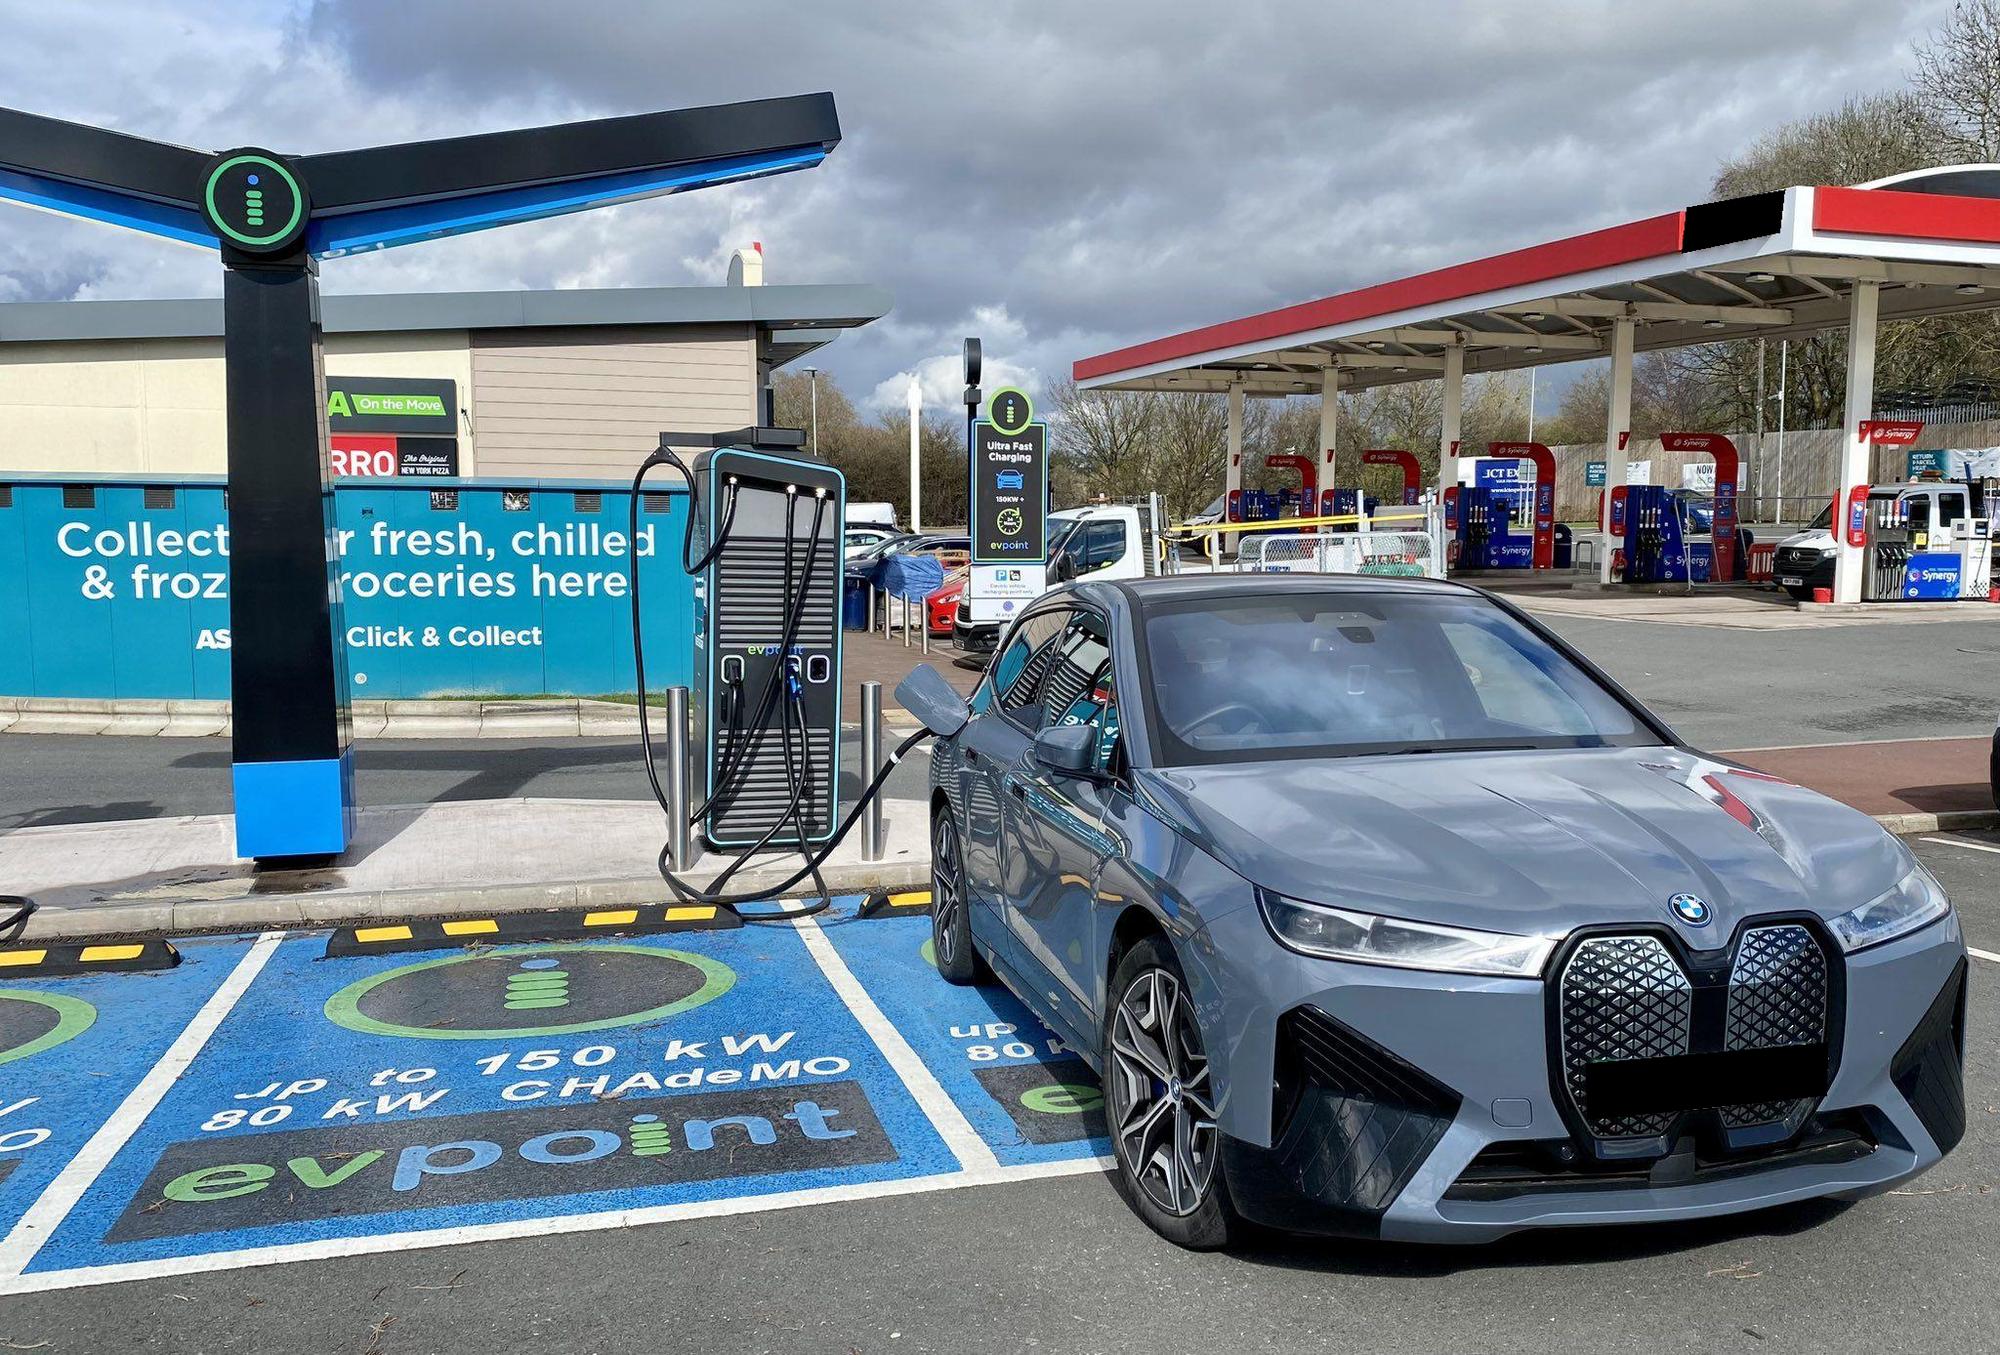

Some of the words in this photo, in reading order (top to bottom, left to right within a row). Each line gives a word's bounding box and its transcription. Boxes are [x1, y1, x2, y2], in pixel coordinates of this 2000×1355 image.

[360, 398, 379, 409] On
[383, 398, 403, 409] the
[406, 399, 440, 411] Move
[1884, 429, 1916, 440] Synergy
[987, 441, 1010, 451] Ultra
[1013, 441, 1033, 451] Fast
[331, 450, 395, 477] RRO
[988, 452, 1032, 463] Charging
[401, 467, 415, 475] NEW
[416, 467, 432, 475] YORK
[432, 467, 450, 475] PIZZA
[1697, 465, 1714, 474] NOW
[57, 521, 230, 558] Collect
[370, 521, 495, 562] fresh,
[511, 522, 656, 557] chilled
[990, 541, 1029, 552] evpoint
[1502, 546, 1530, 556] Synergy
[1676, 555, 1709, 567] Syergy
[81, 564, 115, 600] &
[131, 563, 228, 599] froz
[1922, 569, 1958, 583] Synergy
[346, 626, 414, 647] Click
[421, 626, 441, 647] &
[448, 626, 543, 647] Collect
[949, 1022, 1018, 1039] up
[369, 1068, 437, 1086] to
[474, 1045, 617, 1076] 150
[664, 1031, 796, 1061] kW
[966, 1042, 1035, 1061] 80
[200, 1104, 293, 1131] 80
[322, 1088, 451, 1120] kW
[501, 1056, 851, 1101] CHAdeMO
[163, 1101, 857, 1203] evpoint
